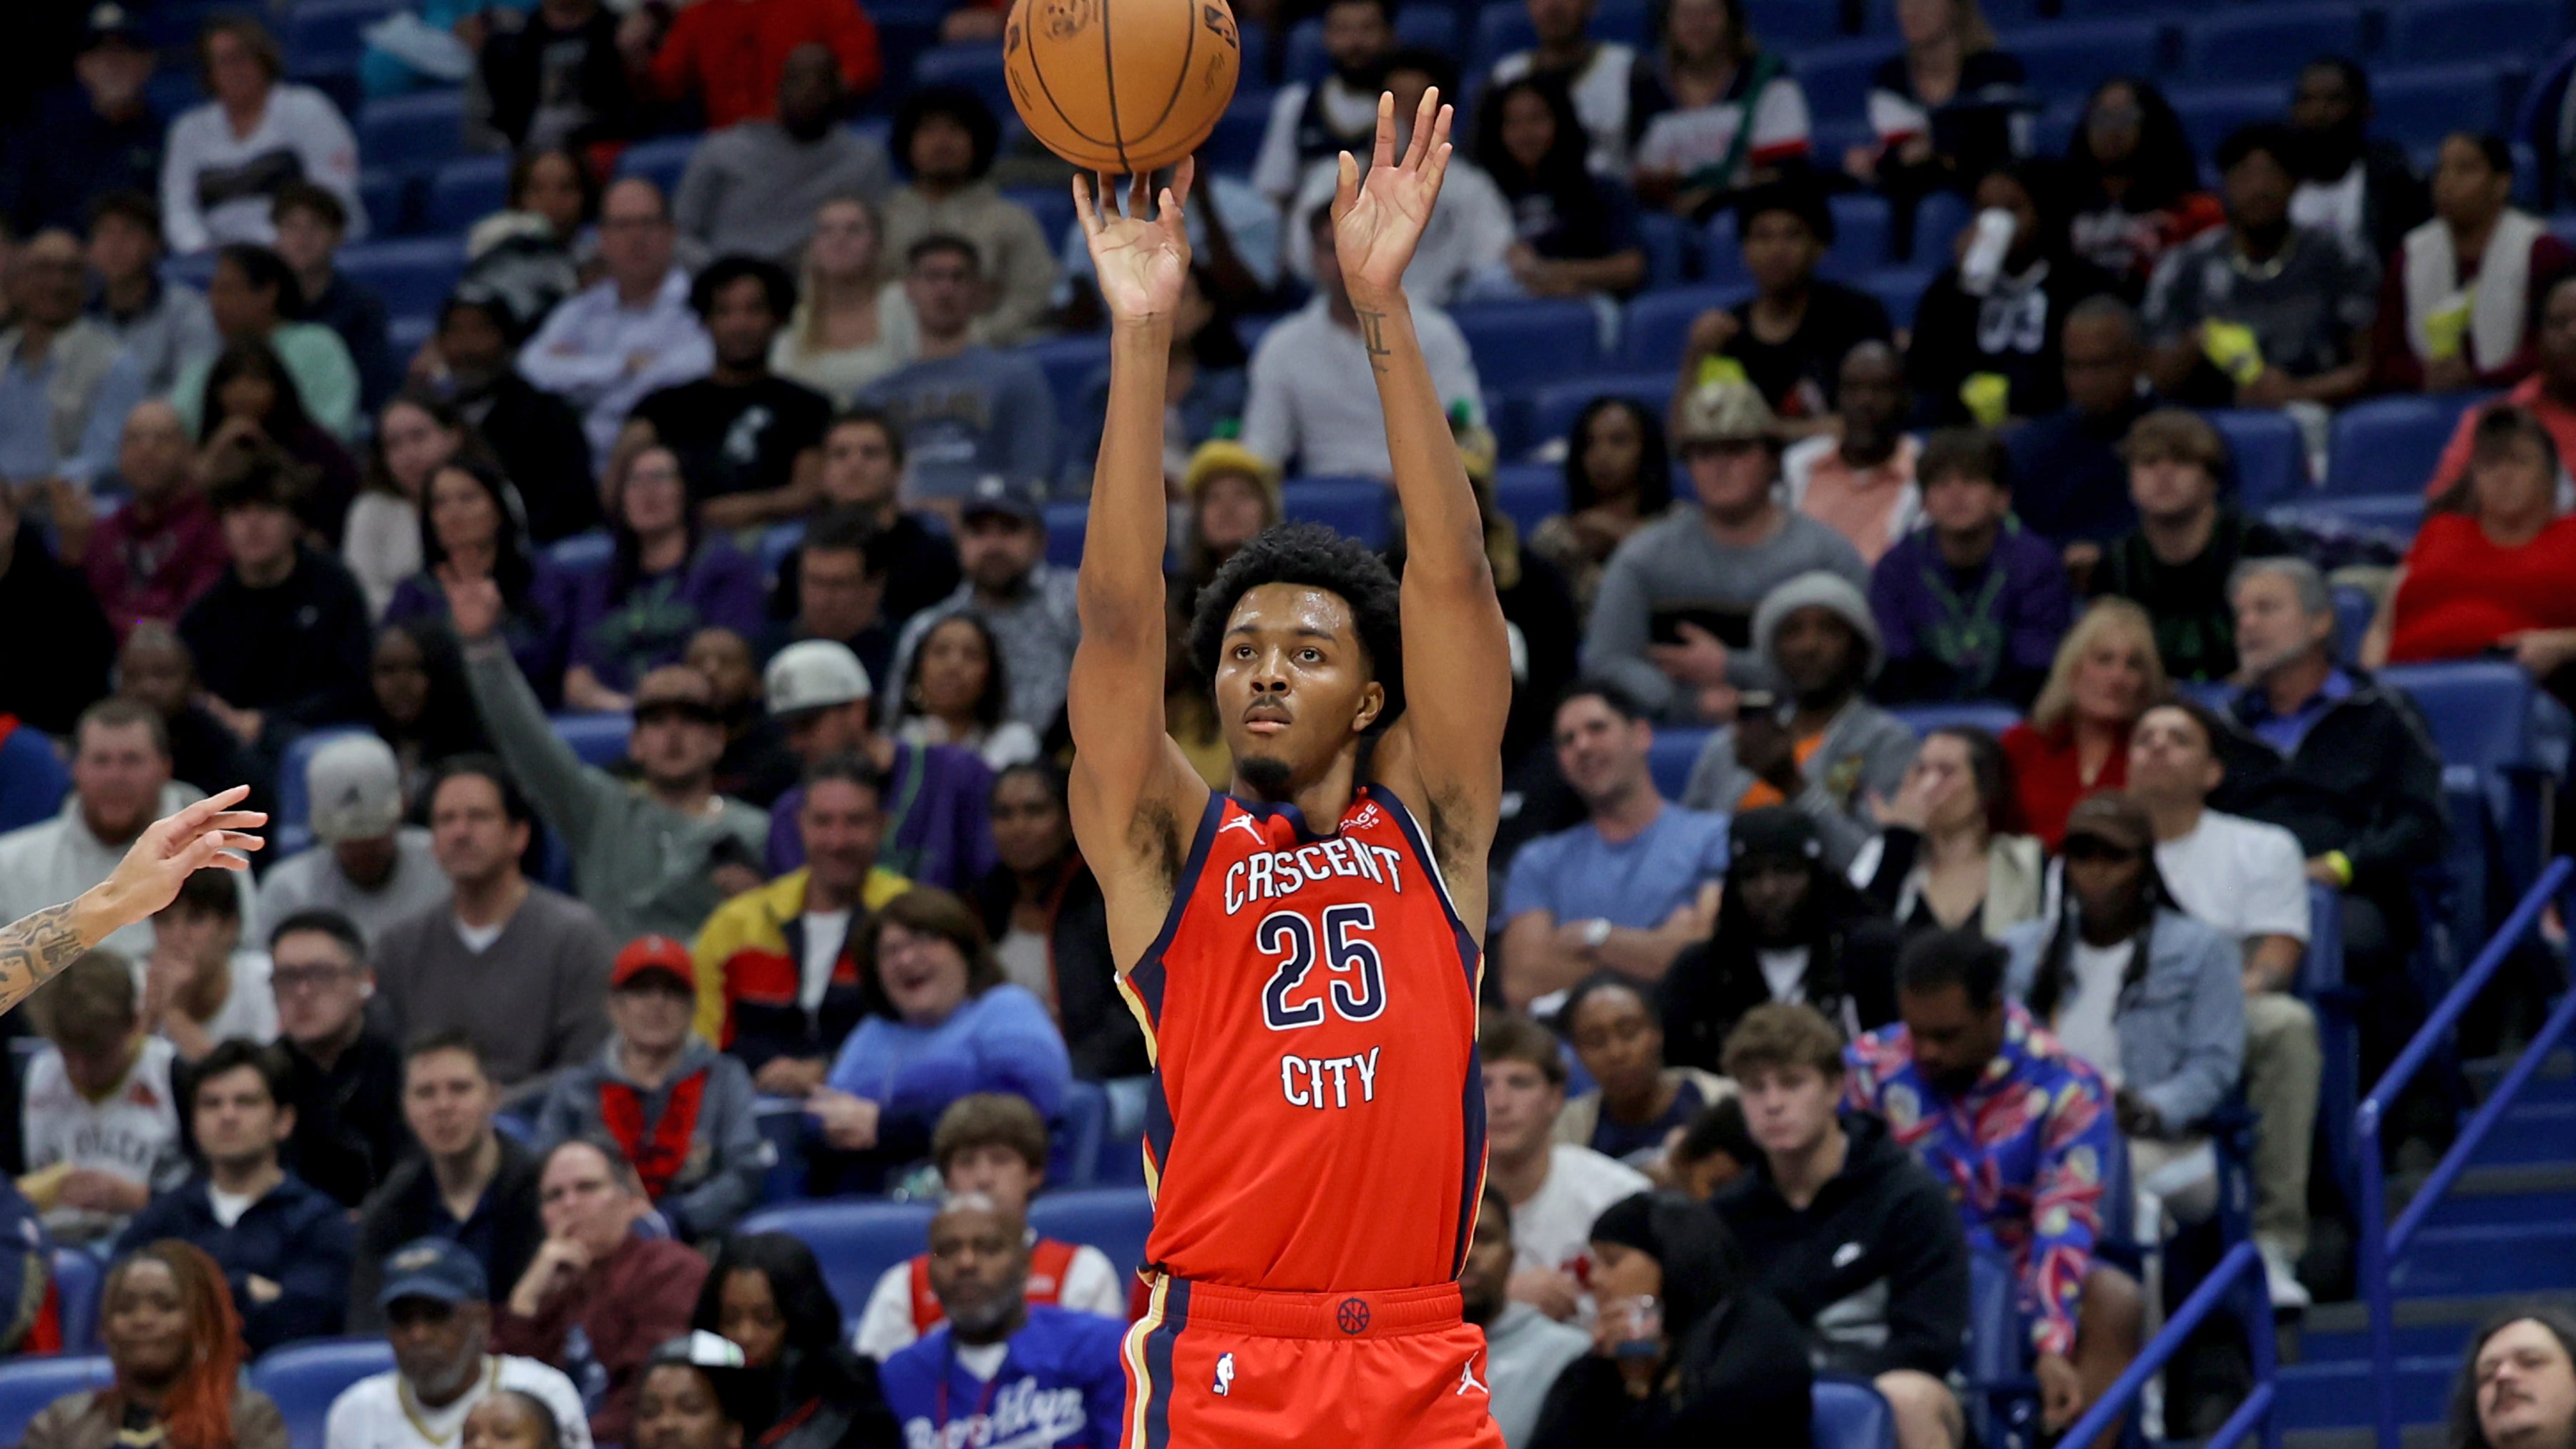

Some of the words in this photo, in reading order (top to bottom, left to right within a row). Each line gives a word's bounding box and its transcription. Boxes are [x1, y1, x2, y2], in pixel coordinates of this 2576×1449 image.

[1224, 836, 1401, 915] CRSCENT
[1256, 902, 1387, 1031] 25
[1280, 1046, 1380, 1109] CITY
